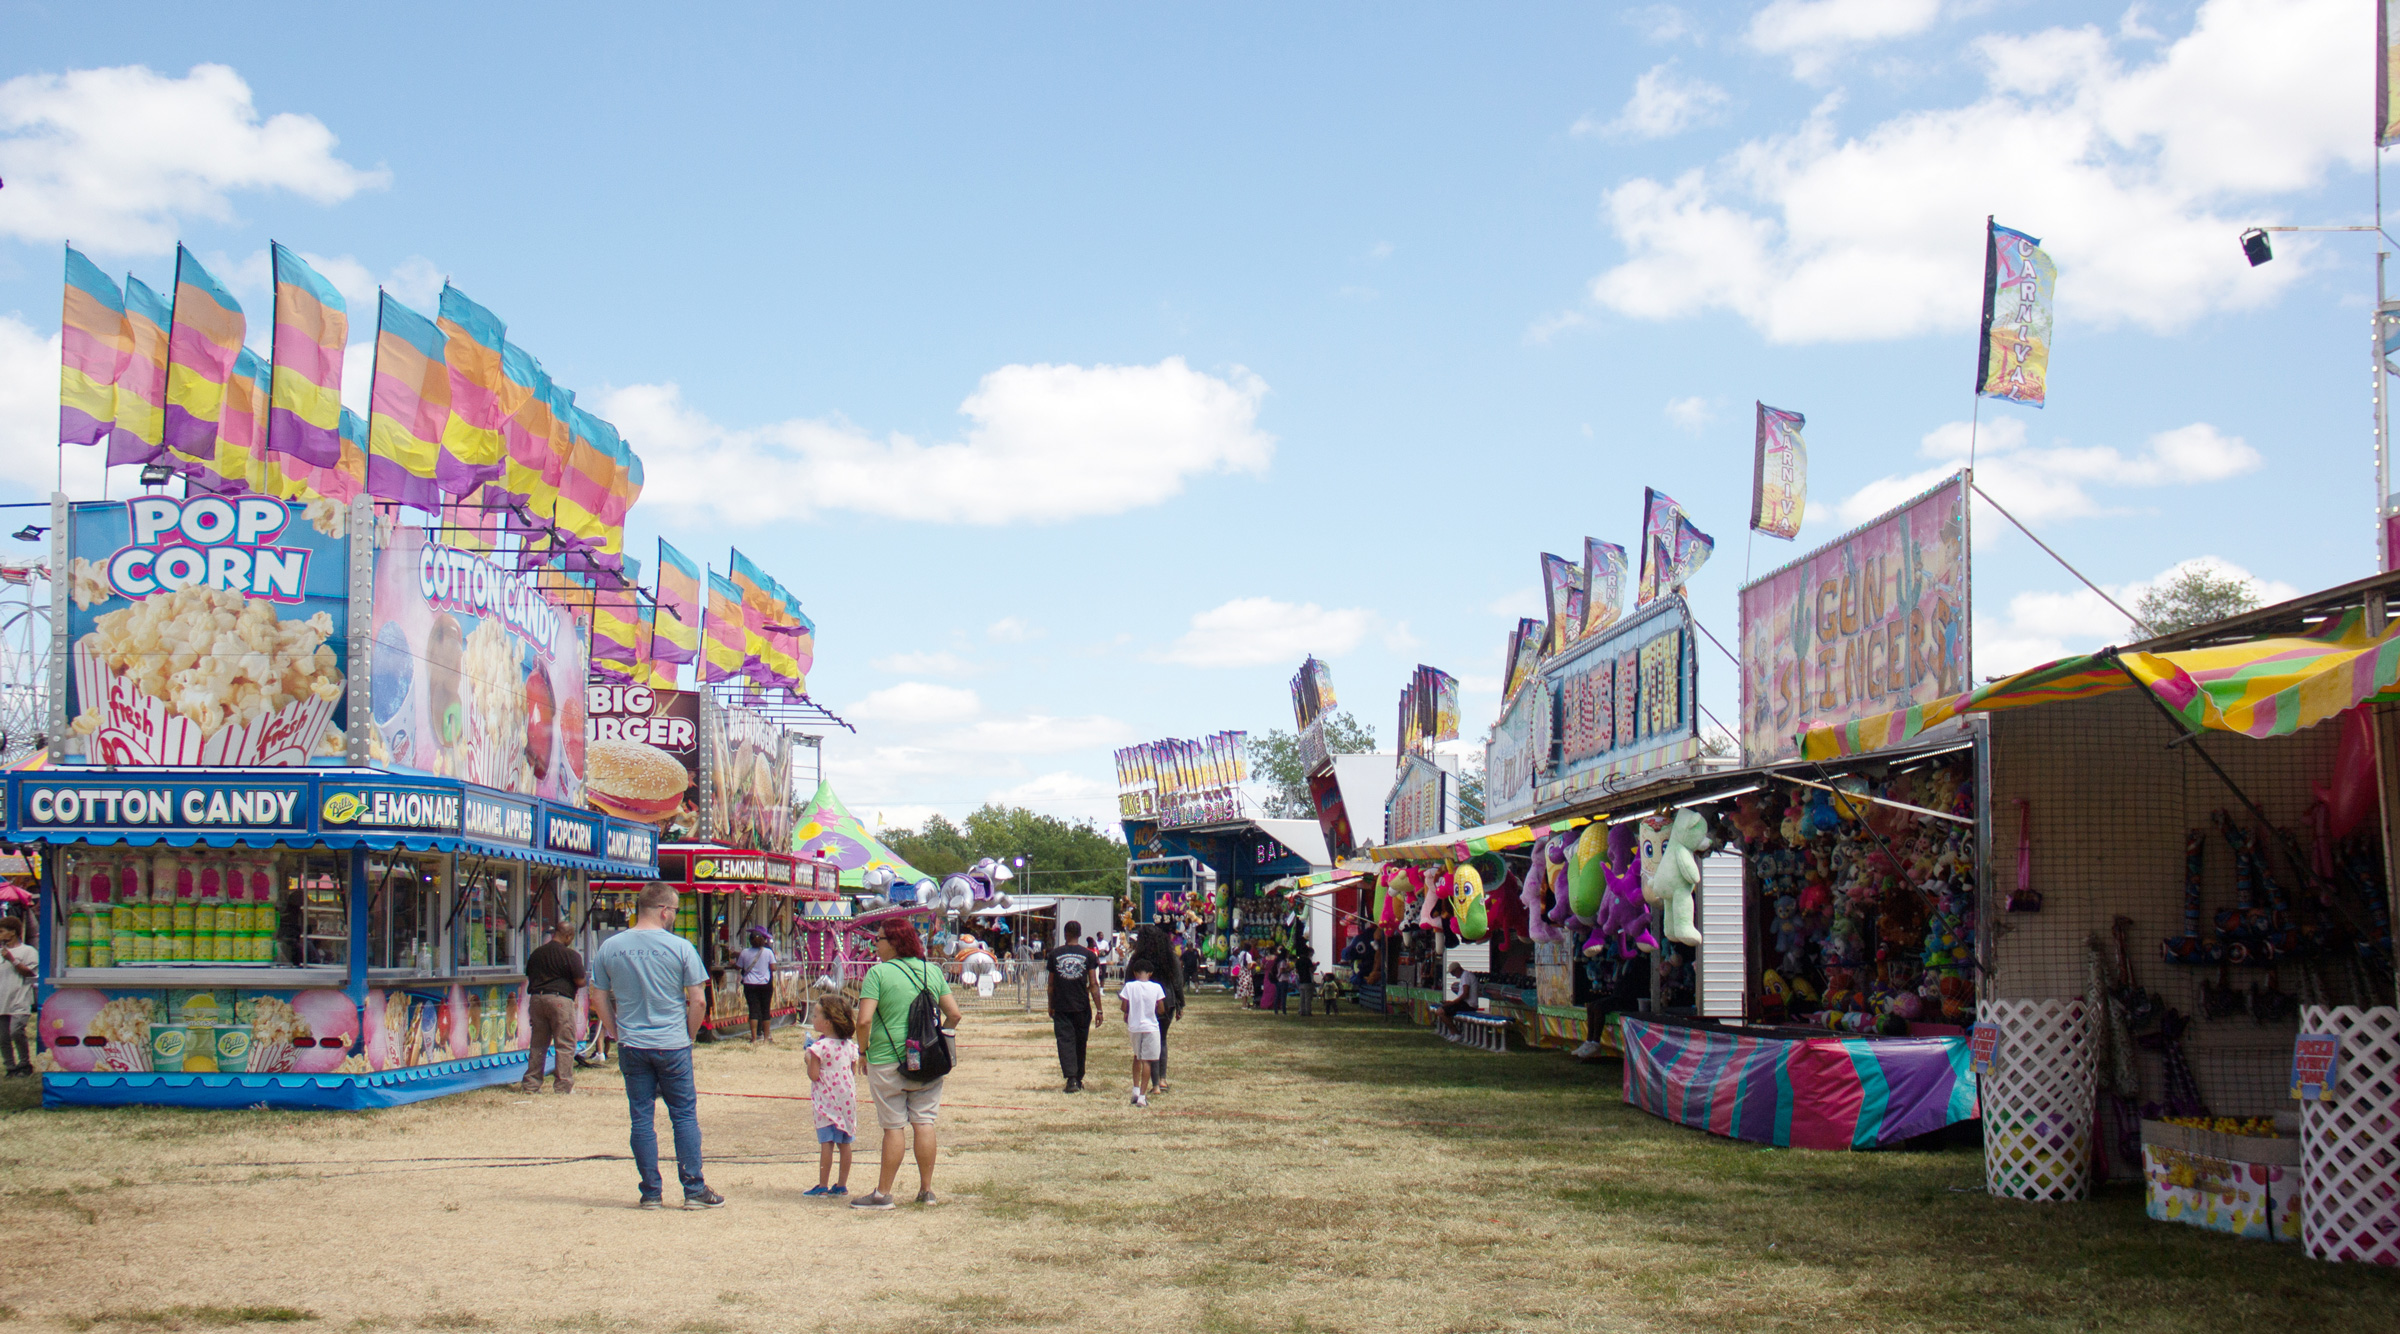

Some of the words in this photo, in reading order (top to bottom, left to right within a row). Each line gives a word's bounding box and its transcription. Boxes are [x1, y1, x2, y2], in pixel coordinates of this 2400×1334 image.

[2010, 238, 2036, 401] CARNIVAL
[133, 498, 285, 546] POP
[111, 545, 306, 597] CORN
[420, 545, 503, 617] COTTON
[503, 574, 560, 658] CANDY
[1816, 553, 1886, 645] GUN
[1776, 597, 1952, 730] SLINGERS
[588, 686, 653, 714] BIG
[1640, 629, 1680, 739] FUN
[110, 684, 154, 737] fresh
[729, 705, 744, 742] BIG
[257, 707, 309, 761] fresh
[31, 788, 173, 823] COTTON
[183, 788, 298, 824] CANDY
[359, 791, 460, 827] LEMONADE
[465, 799, 503, 836] CARAMEL
[504, 806, 533, 843] APPLES
[1118, 795, 1140, 816] TAKE
[550, 816, 592, 851] POPCORN
[607, 829, 628, 857] CANDY
[629, 834, 652, 864] APPLES
[1257, 842, 1294, 864] BAL
[714, 859, 765, 879] LEMONADE
[612, 949, 668, 959] AMERICA
